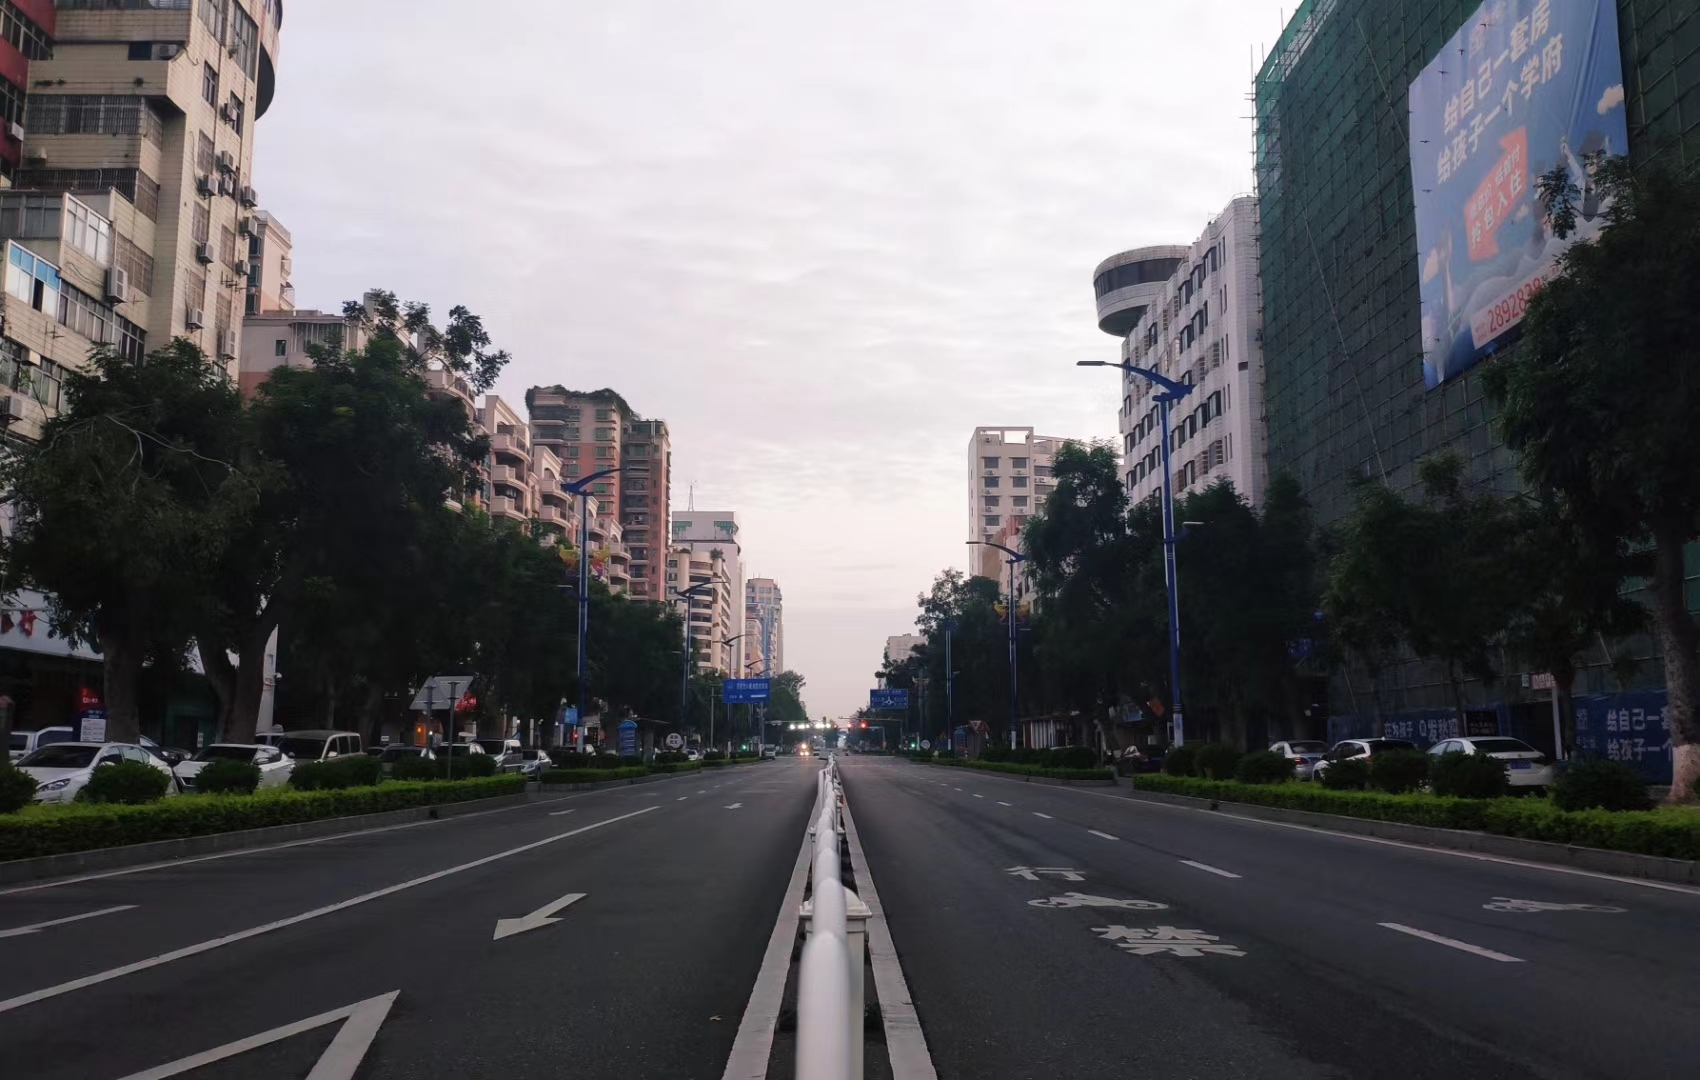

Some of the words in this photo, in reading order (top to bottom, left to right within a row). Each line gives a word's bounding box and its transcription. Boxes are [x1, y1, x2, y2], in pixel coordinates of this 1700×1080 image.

[1437, 33, 1563, 185] 给孩子一个学府
[1444, 0, 1550, 135] 给自己一套房
[1471, 168, 1522, 249] 拎包入住
[1090, 925, 1248, 957] 禁
